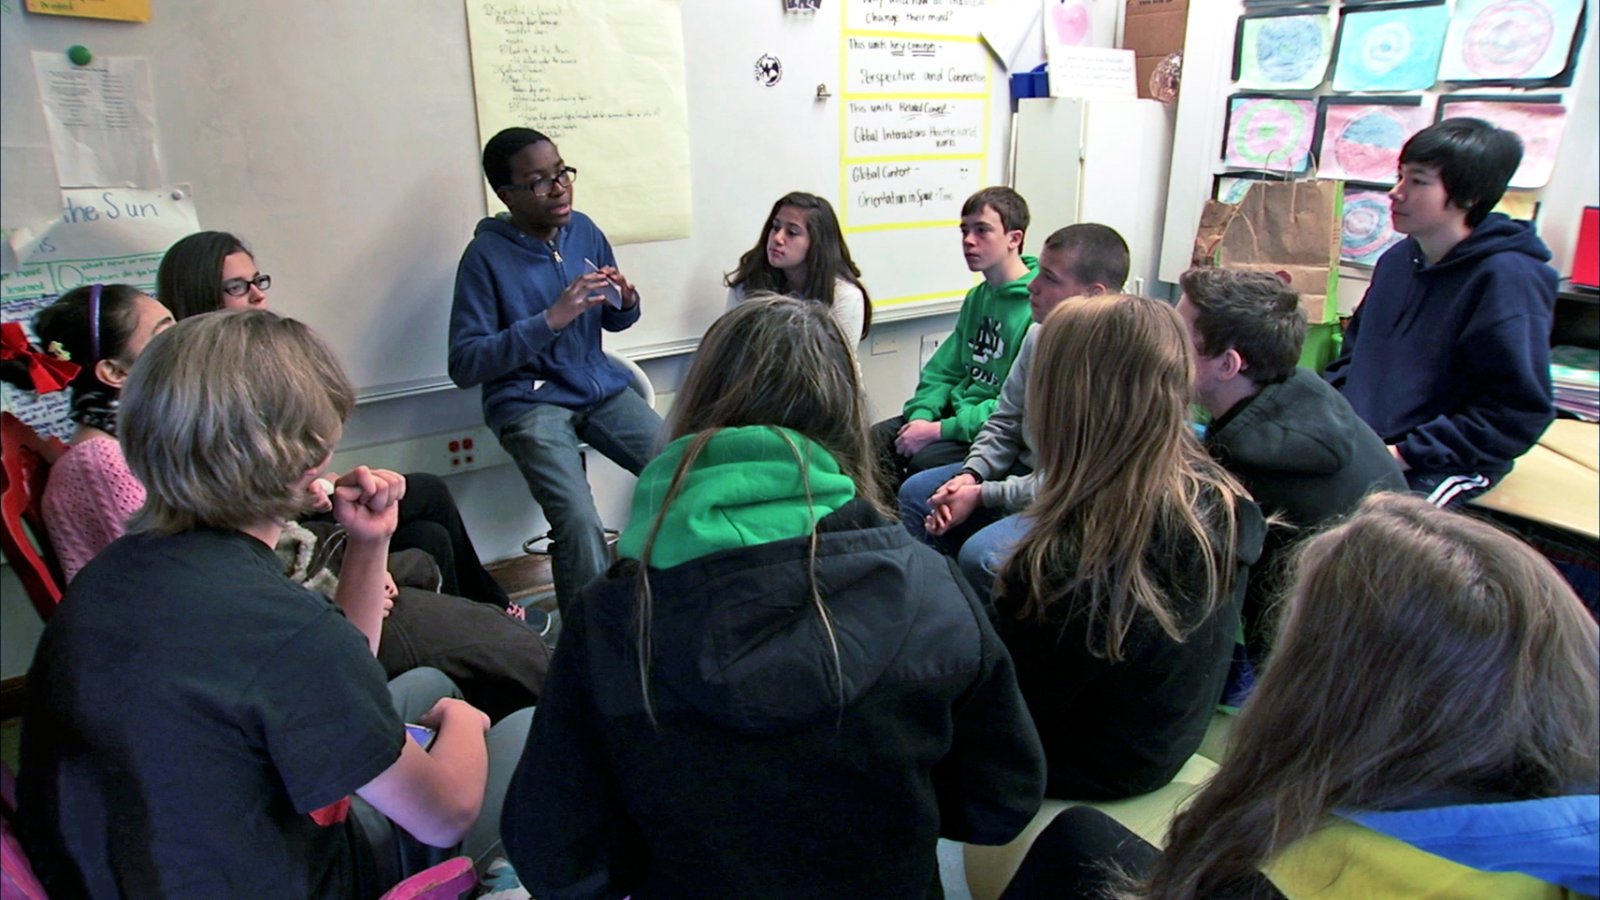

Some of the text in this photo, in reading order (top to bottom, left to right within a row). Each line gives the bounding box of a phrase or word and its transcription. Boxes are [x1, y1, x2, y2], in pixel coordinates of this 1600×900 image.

[906, 12, 925, 22] their
[849, 38, 866, 49] This
[860, 67, 916, 87] Perspective
[923, 67, 944, 83] and
[849, 103, 867, 113] This
[853, 126, 879, 143] Global
[852, 166, 880, 182] Global
[857, 191, 908, 208] Orientation
[62, 192, 159, 224] the Sun
